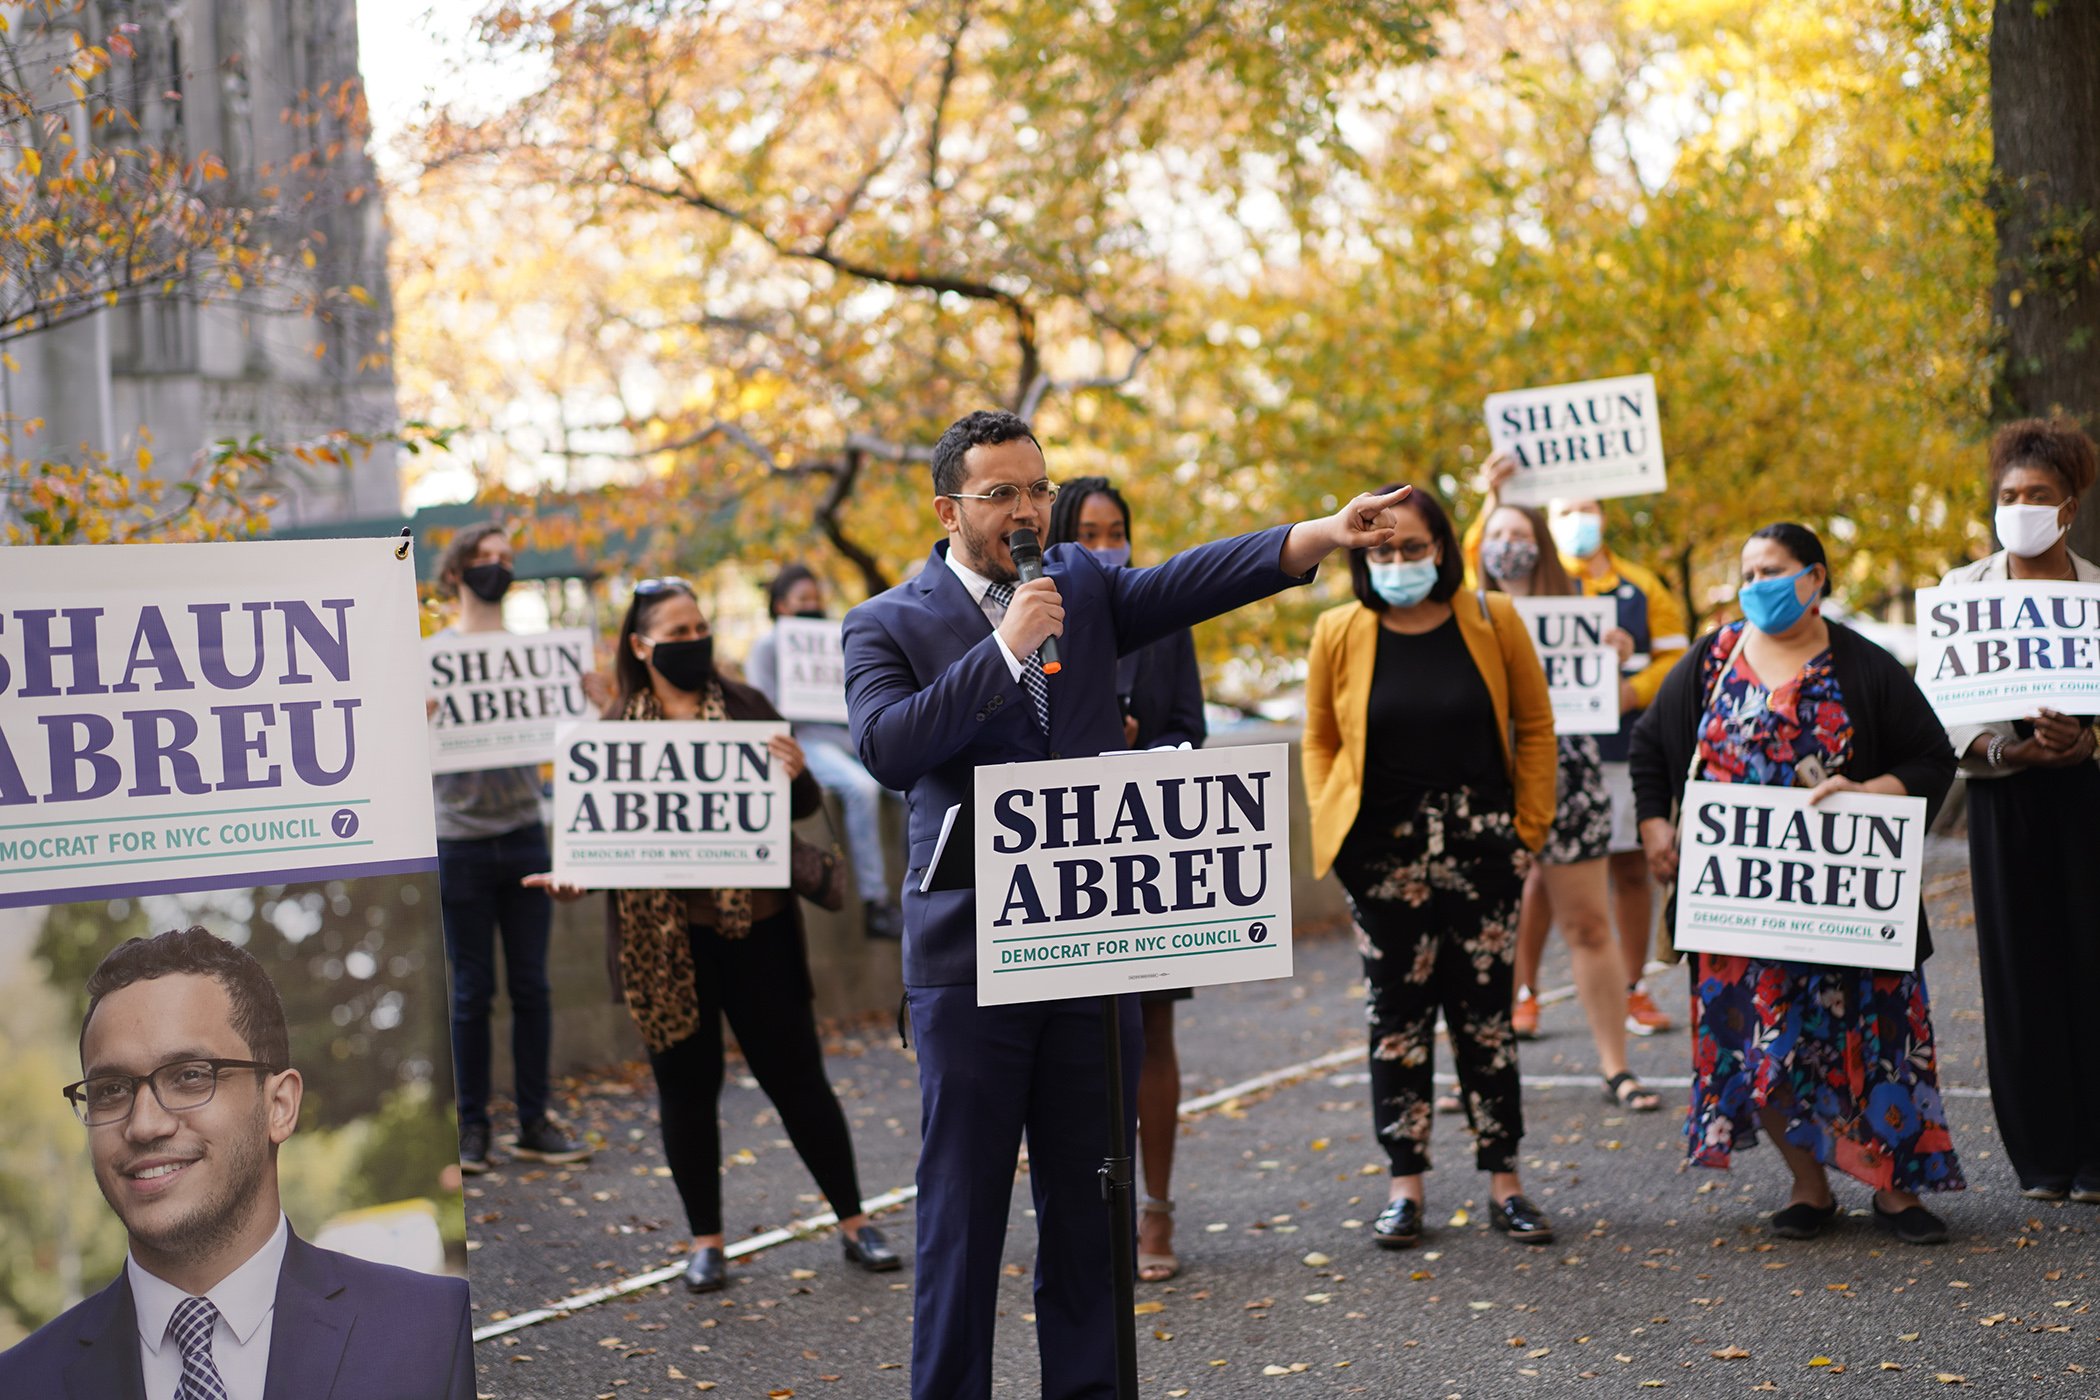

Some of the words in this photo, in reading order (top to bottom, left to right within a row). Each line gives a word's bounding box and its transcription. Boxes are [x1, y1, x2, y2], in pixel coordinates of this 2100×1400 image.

[1501, 391, 1643, 439] SHAUN
[1511, 426, 1648, 469] ABREU
[0, 598, 355, 698] HAUN
[431, 643, 585, 689] SHAUN
[1931, 636, 2100, 682] ABRE
[436, 685, 588, 729] ABREU
[2060, 681, 2100, 691] COUNC
[568, 741, 771, 784] SHAUN
[567, 791, 776, 833] ABREU
[993, 771, 1271, 854] SHAUN
[1696, 802, 1910, 859] SHAUN
[0, 834, 99, 862] MOCRAT
[109, 831, 157, 853] FOR
[166, 826, 211, 848] NYC
[219, 819, 321, 844] COUNCIL
[641, 849, 665, 858] FOR
[670, 849, 692, 858] NYC
[698, 849, 748, 858] COUNCIL
[993, 843, 1272, 927] ABREU
[1691, 854, 1906, 911] ABREU
[1693, 911, 1757, 926] DEMOCRAT
[1762, 917, 1786, 930] FOR
[1791, 921, 1814, 932] NYC
[1819, 923, 1874, 938] COUNCIL
[1001, 943, 1091, 964] DEMOCRAT
[1097, 940, 1129, 955] FOR
[1135, 936, 1166, 951] NYC
[1172, 930, 1241, 948] COUNCIL
